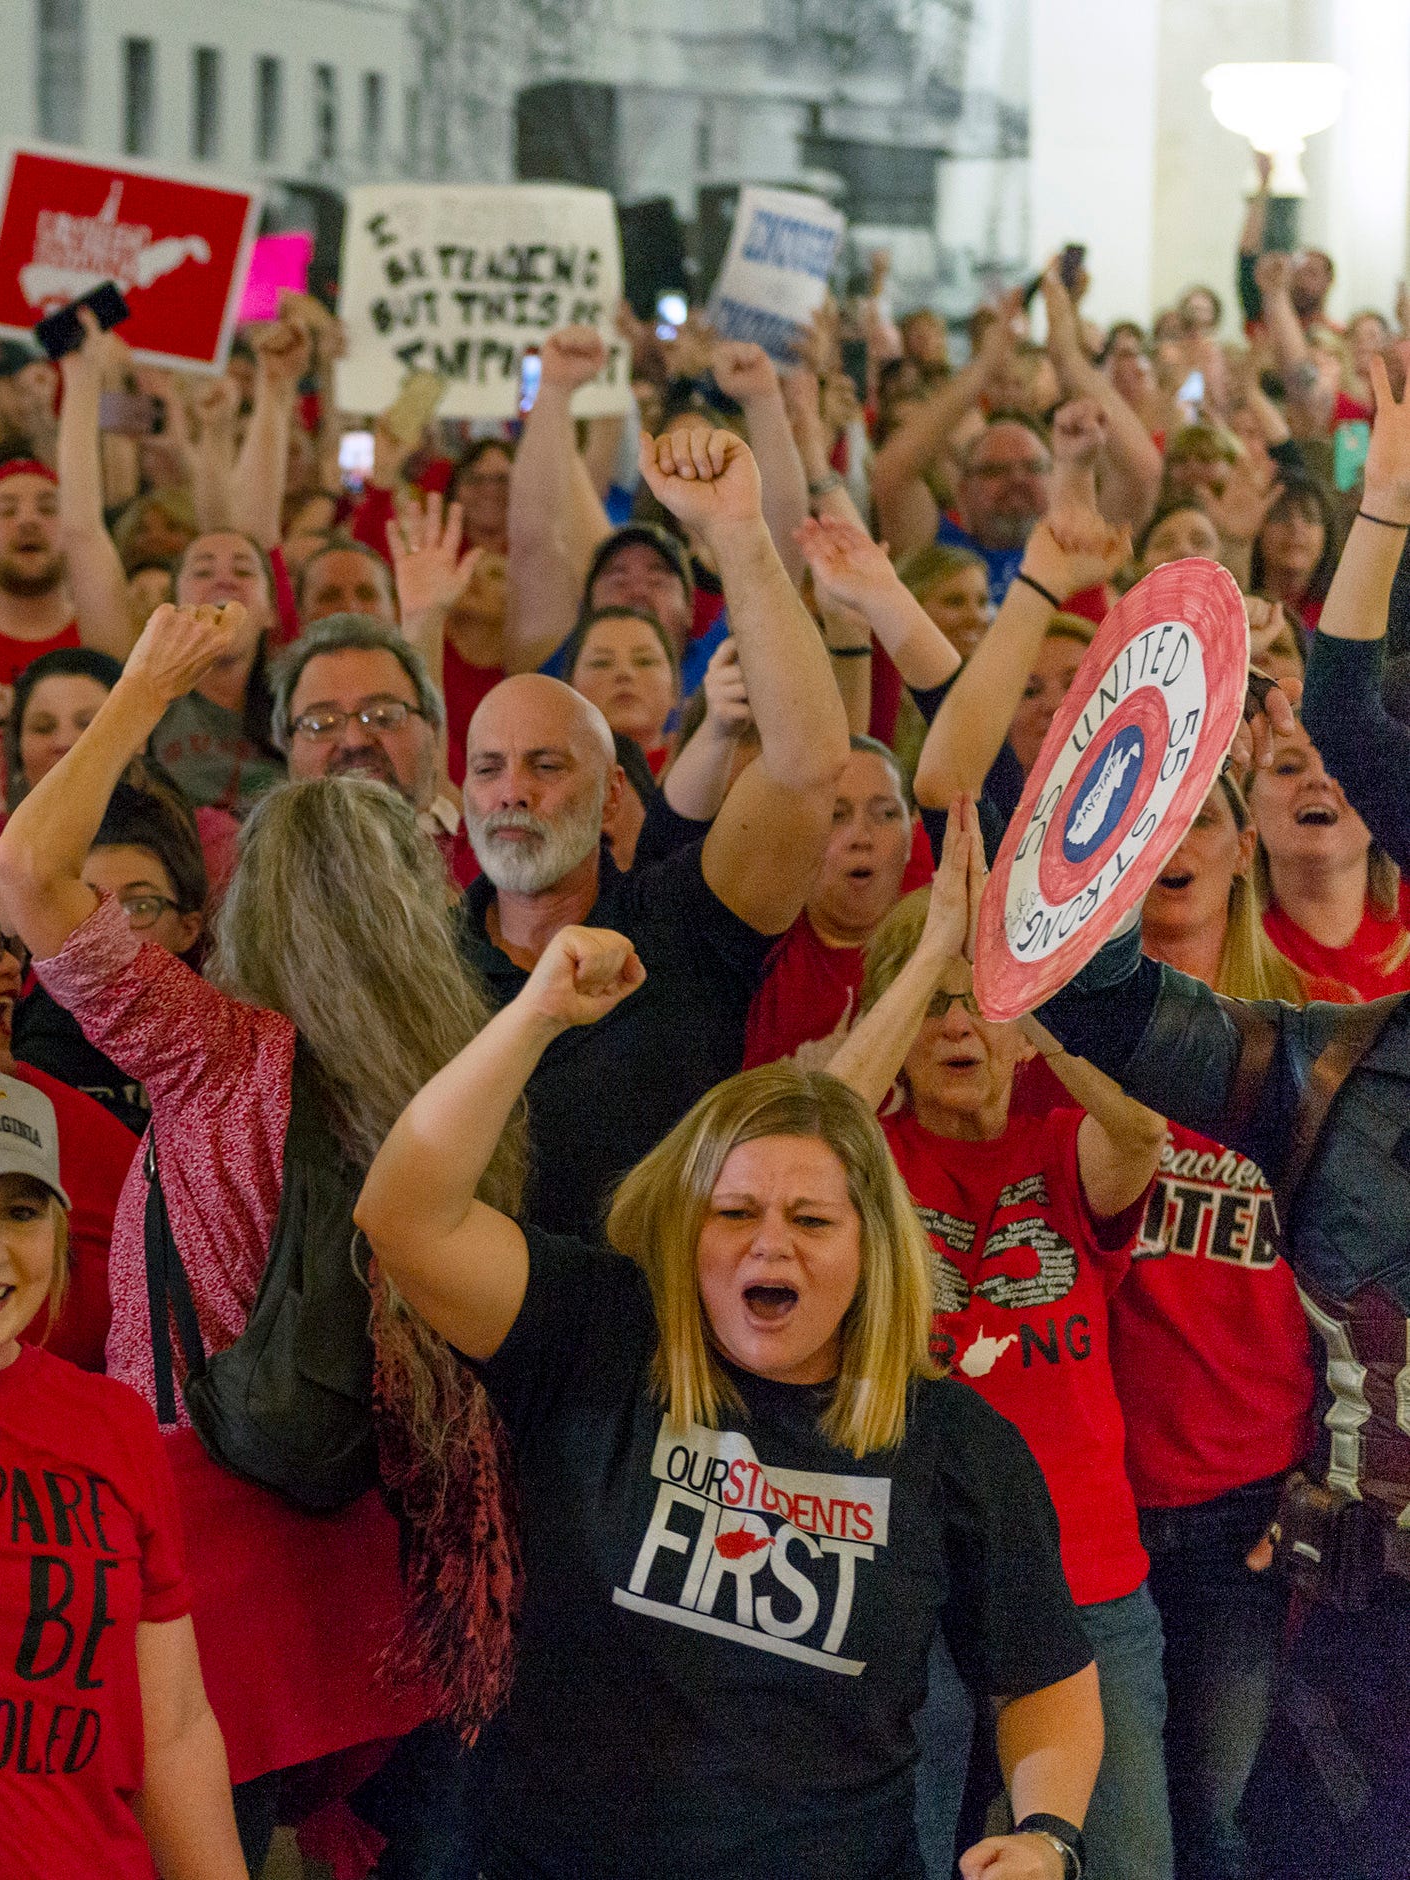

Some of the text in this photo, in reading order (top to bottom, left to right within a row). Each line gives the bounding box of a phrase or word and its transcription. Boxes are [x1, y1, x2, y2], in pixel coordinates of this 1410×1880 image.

[1070, 625, 1191, 754] UNITED
[1016, 804, 1158, 955] STRONG
[667, 1445, 730, 1502] OUR
[14, 1554, 120, 1691] BE
[628, 1482, 875, 1654] FIRST
